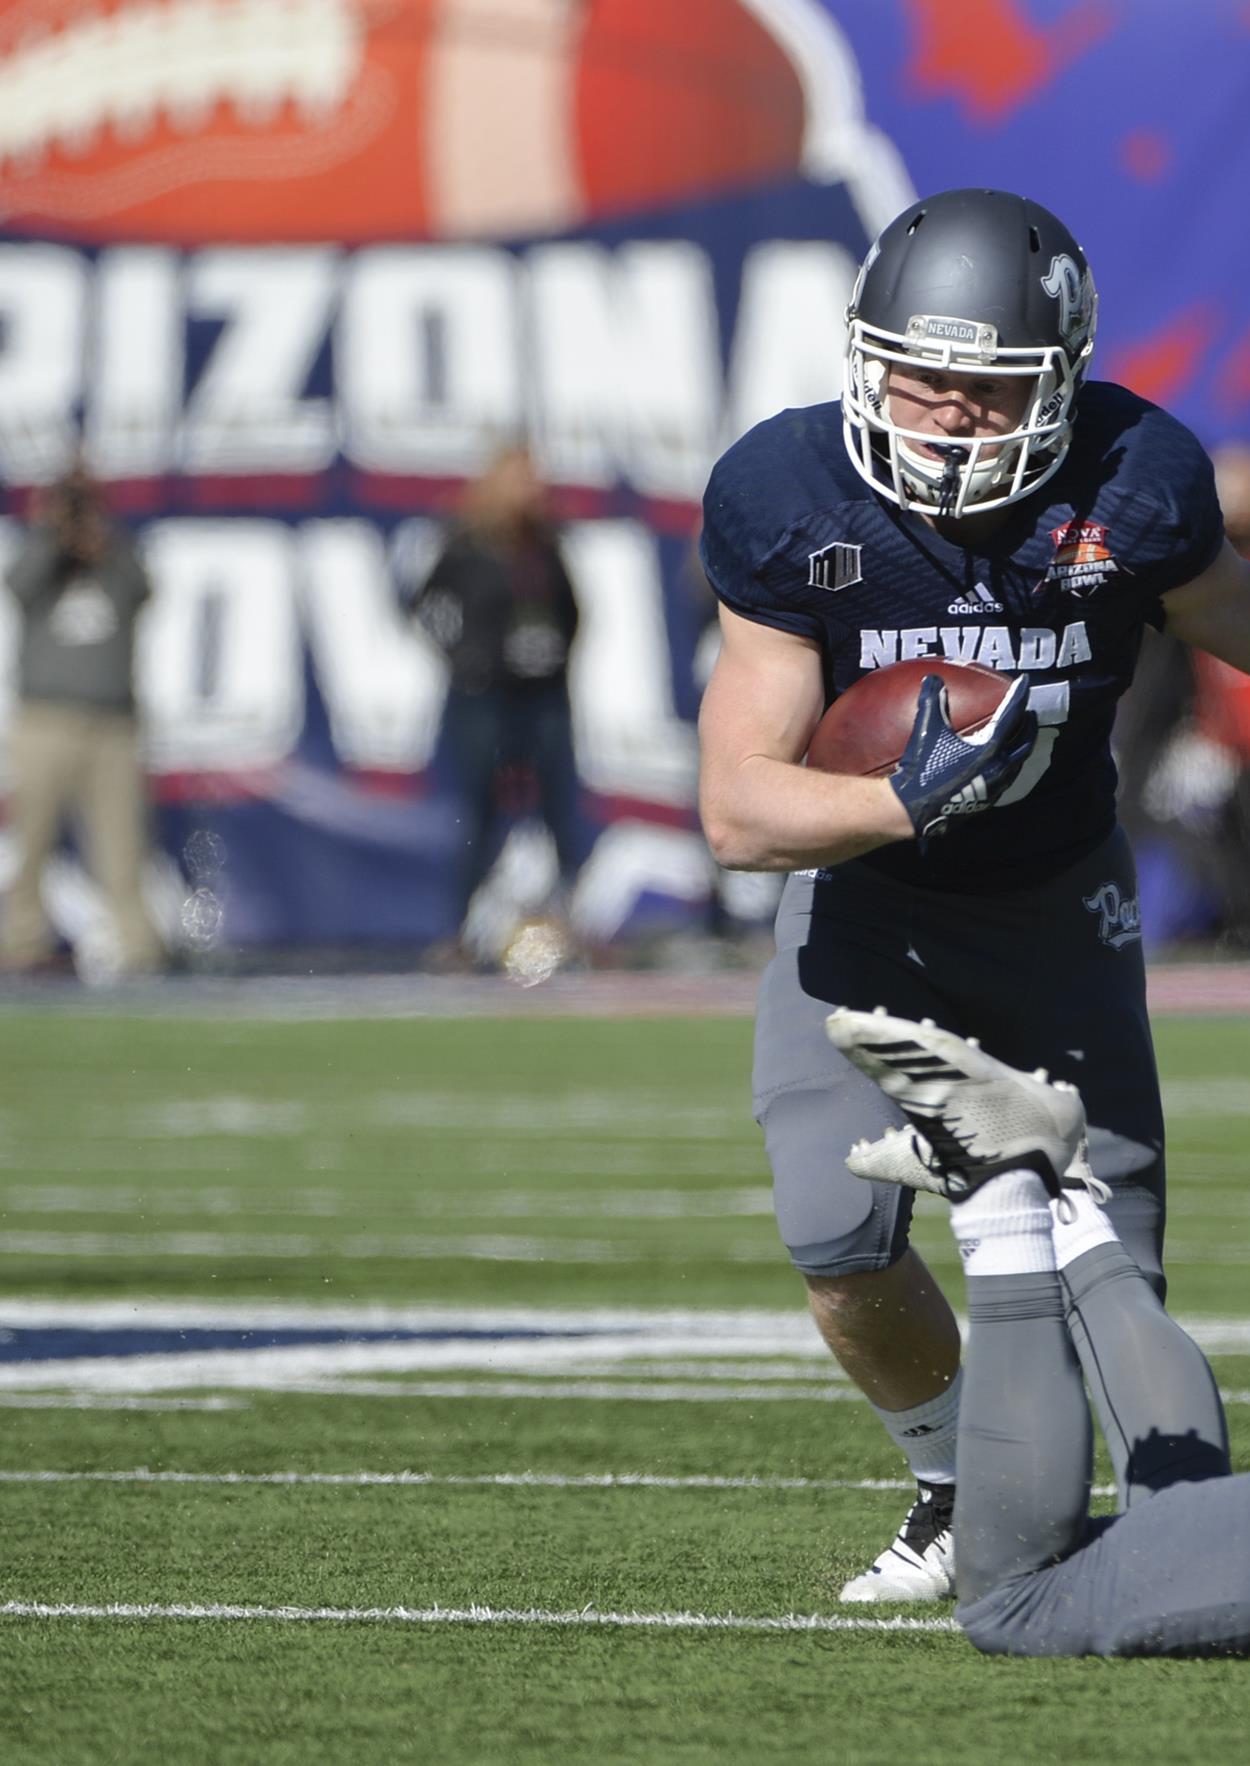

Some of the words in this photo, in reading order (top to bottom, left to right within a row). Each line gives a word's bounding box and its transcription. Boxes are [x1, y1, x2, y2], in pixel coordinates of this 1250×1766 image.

[927, 322, 974, 340] NEVADA
[1046, 559, 1118, 580] ARIZONA
[1061, 572, 1108, 592] BOWL
[947, 600, 1004, 615] adidas
[859, 621, 1092, 670] NEVADA
[60, 517, 700, 796] OL
